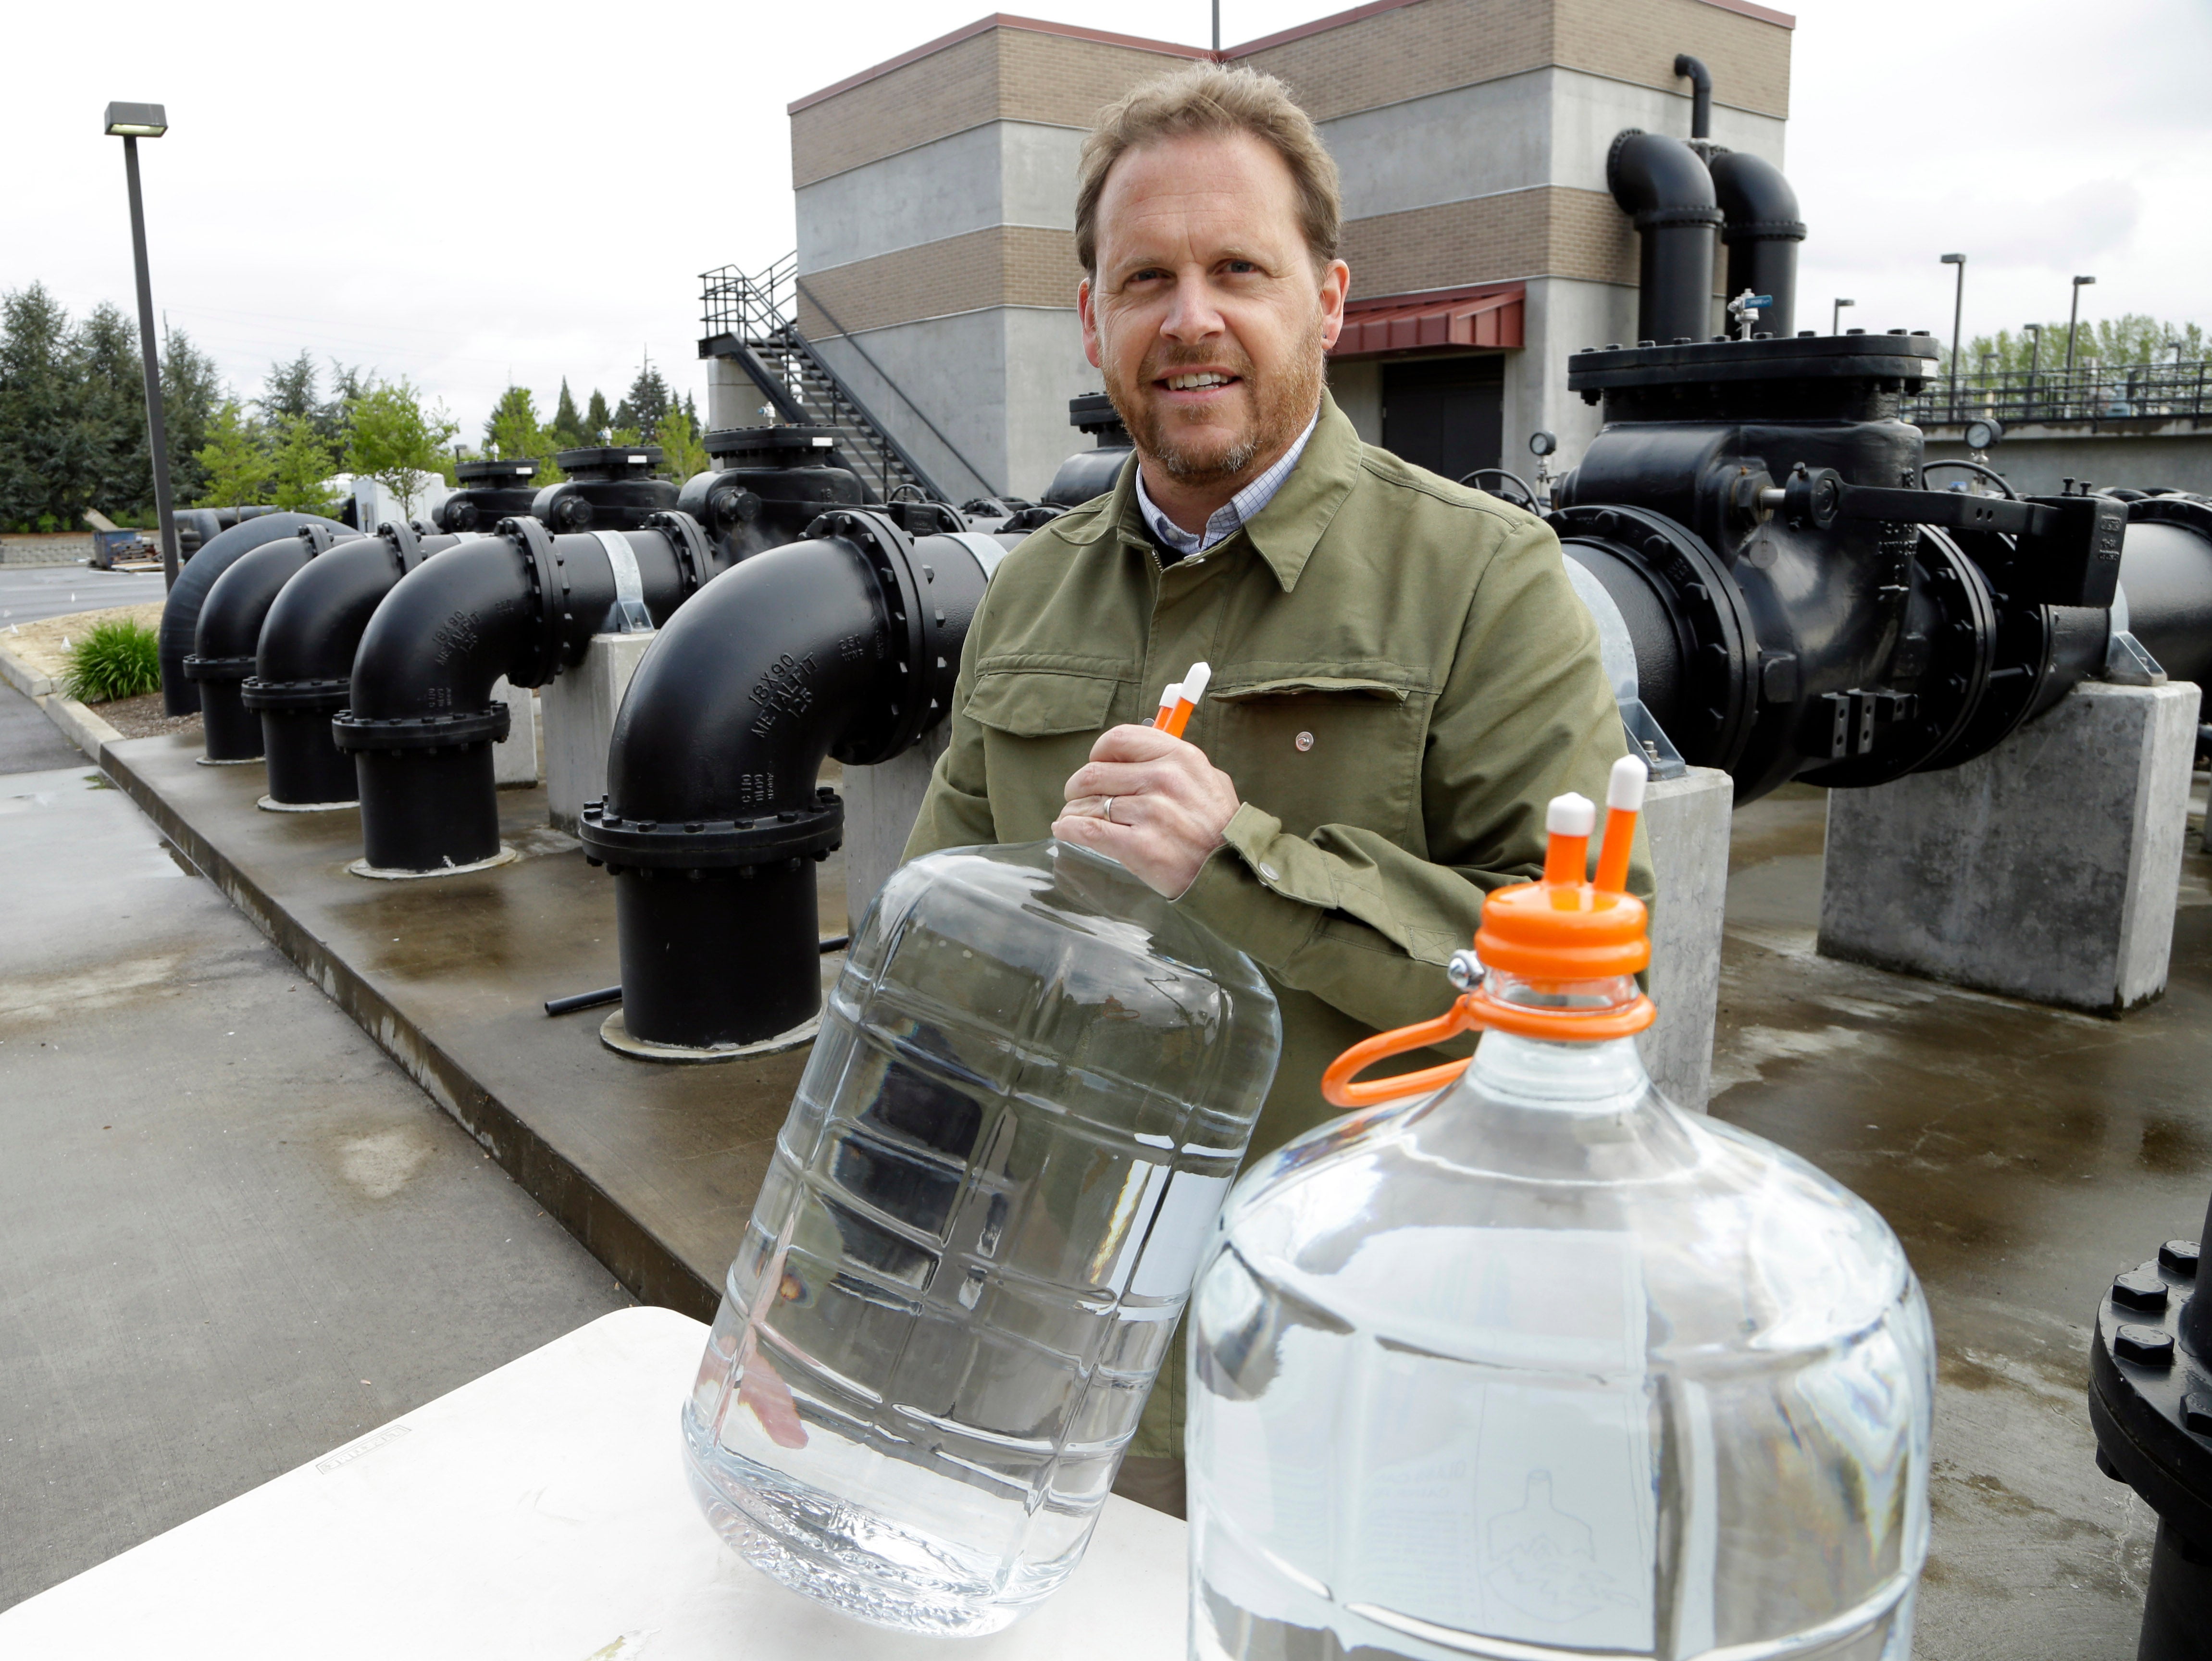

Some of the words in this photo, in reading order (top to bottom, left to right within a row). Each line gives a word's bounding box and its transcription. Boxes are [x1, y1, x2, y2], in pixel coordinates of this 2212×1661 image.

[432, 610, 464, 645] 18X90
[435, 610, 481, 666] METALFIT
[749, 652, 795, 707] 18X90
[751, 652, 817, 738] METALFIT
[788, 687, 812, 719] 125
[328, 1429, 400, 1469] LIFETIME
